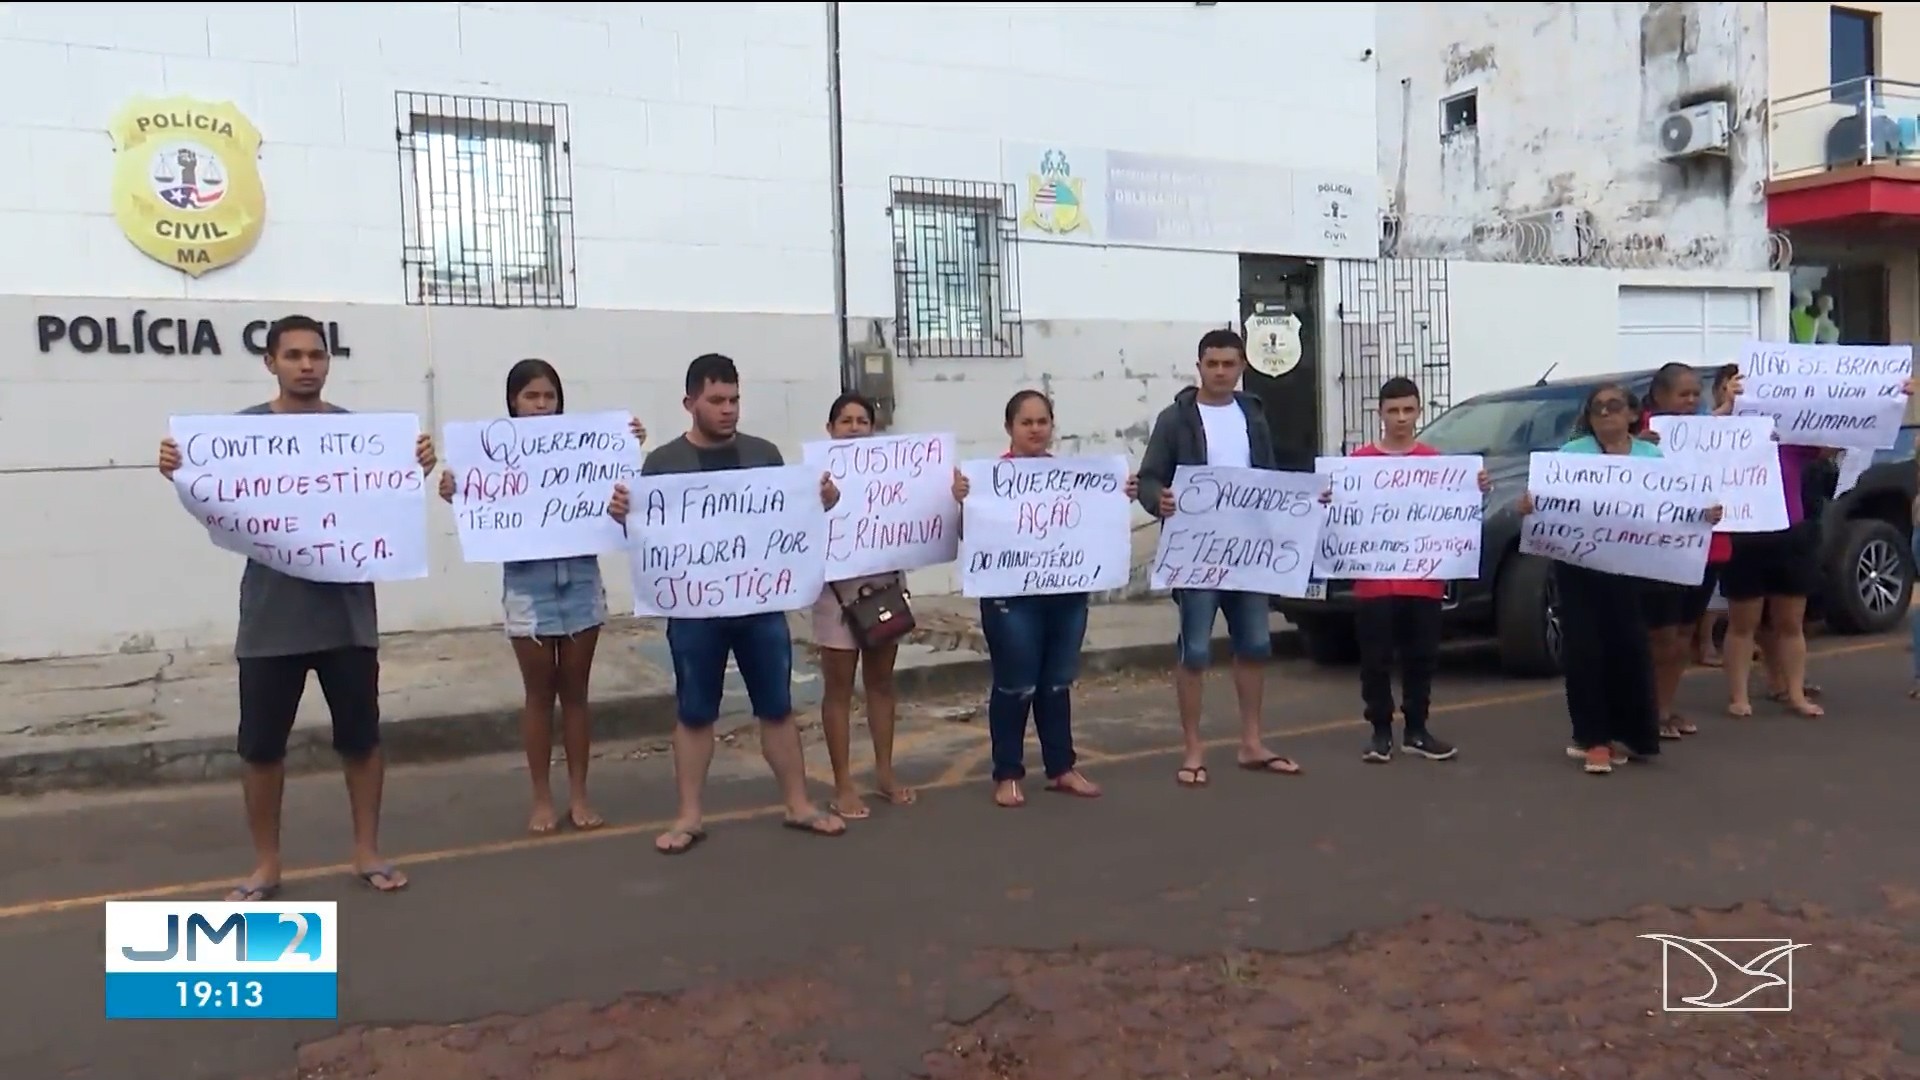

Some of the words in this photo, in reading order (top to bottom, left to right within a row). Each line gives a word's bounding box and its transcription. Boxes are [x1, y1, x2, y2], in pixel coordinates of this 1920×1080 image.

[136, 110, 234, 138] POLÍCIA
[155, 219, 228, 240] CIVIL
[177, 248, 211, 264] MA
[37, 309, 222, 355] POLÍCIA
[1748, 350, 1790, 378] NÃO
[1836, 355, 1911, 377] BRINCA
[1757, 382, 1797, 399] COM
[1804, 386, 1815, 399] A
[1828, 381, 1867, 399] VIDA
[187, 433, 300, 466] CONTRA
[320, 433, 385, 456] ATOS
[481, 418, 626, 470] QUEREMOS
[1669, 421, 1689, 451] O
[828, 437, 942, 479] JUSTIÇA
[190, 466, 422, 503] CLANDESTINOS
[463, 465, 529, 505] AÇÃO
[540, 467, 569, 489] DO
[992, 460, 1117, 499] QUEREMOS
[1330, 466, 1361, 494] FOI
[1374, 467, 1467, 492] CRIME!!!
[1546, 460, 1633, 484] QUANTO
[1643, 473, 1712, 493] CUSTA
[1720, 465, 1768, 486] LUTA
[646, 488, 665, 526] A
[682, 484, 785, 524] FAMÍLIA
[865, 479, 907, 513] POR
[1178, 472, 1312, 517] SAUDADES
[1534, 494, 1580, 514] UMA
[1593, 501, 1645, 520] VIDA
[206, 512, 300, 535] ACIONE
[322, 512, 337, 534] A
[1017, 494, 1082, 540] AÇÃO
[1326, 500, 1364, 527] NÃO
[1371, 503, 1400, 524] FOI
[1407, 502, 1485, 522] ACIDENTE
[826, 512, 943, 561] ERINALVA
[1321, 533, 1409, 560] QUEREMOS
[1531, 521, 1585, 540] ATOS
[253, 537, 393, 568] JUSTIÇA.
[642, 535, 746, 572] IMPLORA
[764, 528, 809, 560] POR
[969, 550, 993, 573] DO
[996, 543, 1085, 570] MINISTÉRIO
[1156, 529, 1300, 574] ETERNAS
[1402, 558, 1442, 579] ERY
[654, 567, 796, 610] JUSTIÇA.
